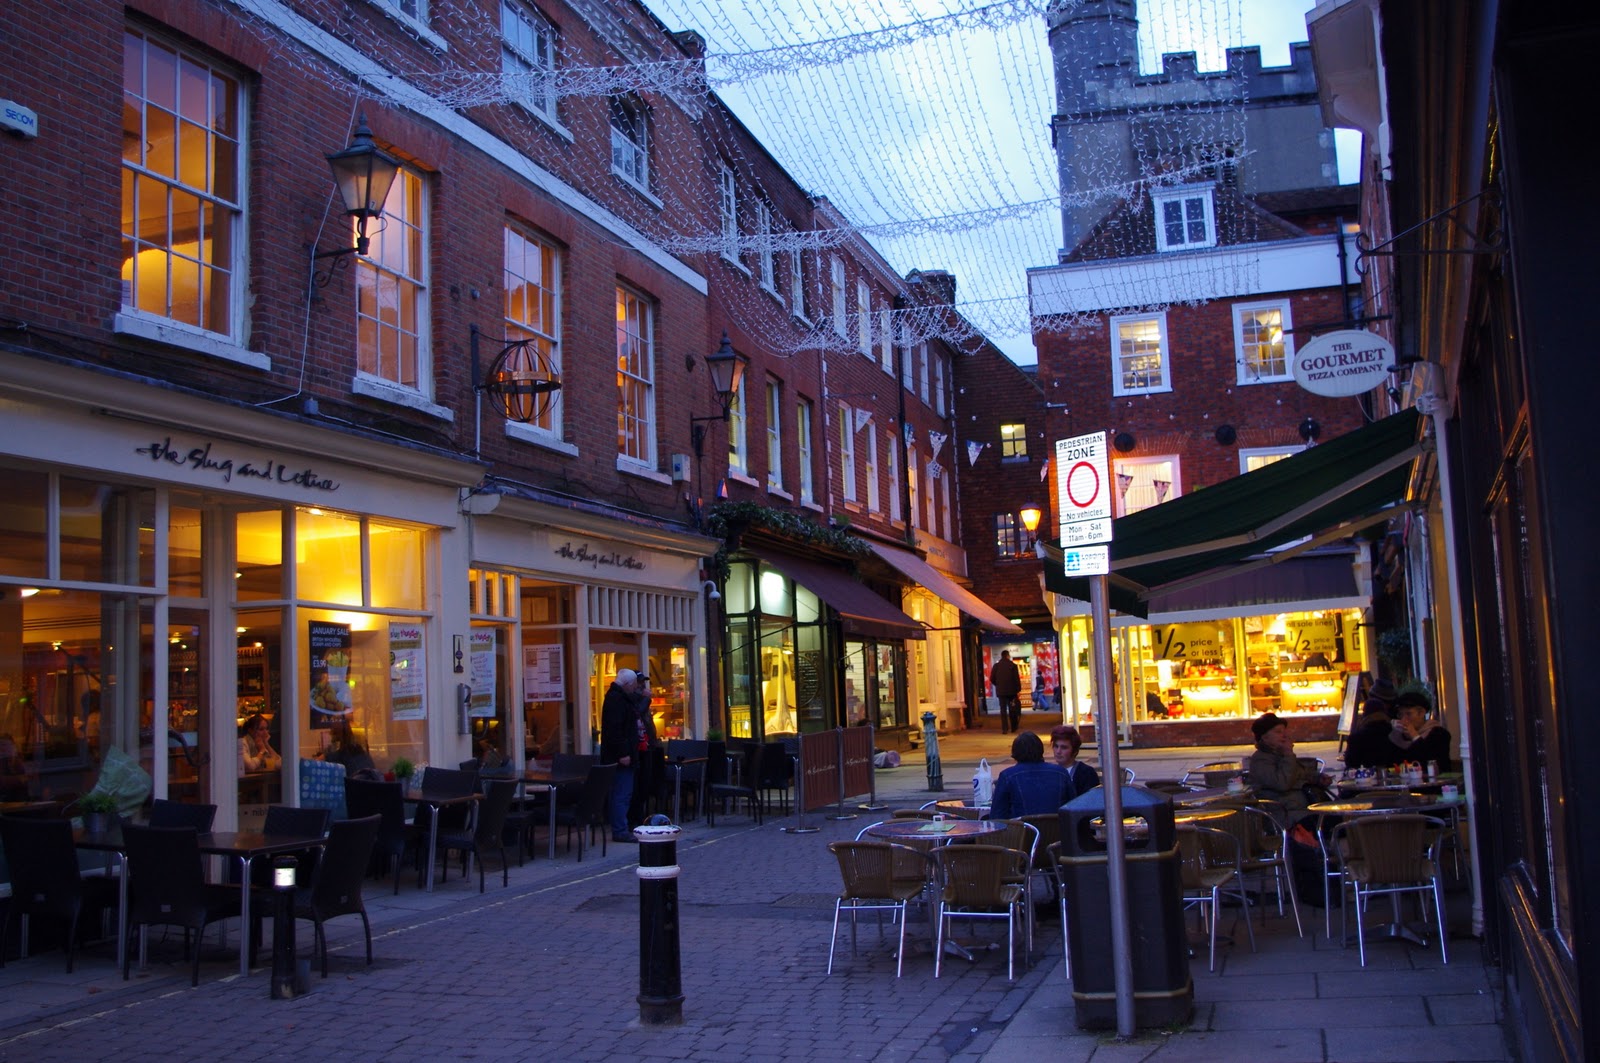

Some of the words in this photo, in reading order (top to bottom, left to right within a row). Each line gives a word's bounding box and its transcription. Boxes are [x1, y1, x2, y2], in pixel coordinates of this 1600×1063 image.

[5, 108, 34, 127] SECOM
[1332, 342, 1352, 352] THE
[1300, 347, 1386, 371] GOURMET
[1308, 371, 1335, 381] PIZZA
[1336, 363, 1383, 377] COMPANY
[1059, 434, 1103, 450] PEDESTRIAN
[1067, 446, 1096, 461] ZONE
[136, 436, 187, 464] the
[187, 442, 233, 483] Slug
[237, 460, 273, 480] and
[277, 464, 341, 491] Lettuce
[1066, 512, 1076, 520] No
[1076, 508, 1103, 519] vehicles
[1068, 525, 1082, 534] Mon
[1090, 523, 1102, 531] Sat
[1315, 619, 1332, 627] lines
[312, 627, 336, 635] JANUARY
[337, 628, 349, 636] SALE
[1154, 628, 1186, 658] 1/2
[1190, 638, 1212, 647] price
[1289, 629, 1311, 651] 1/2
